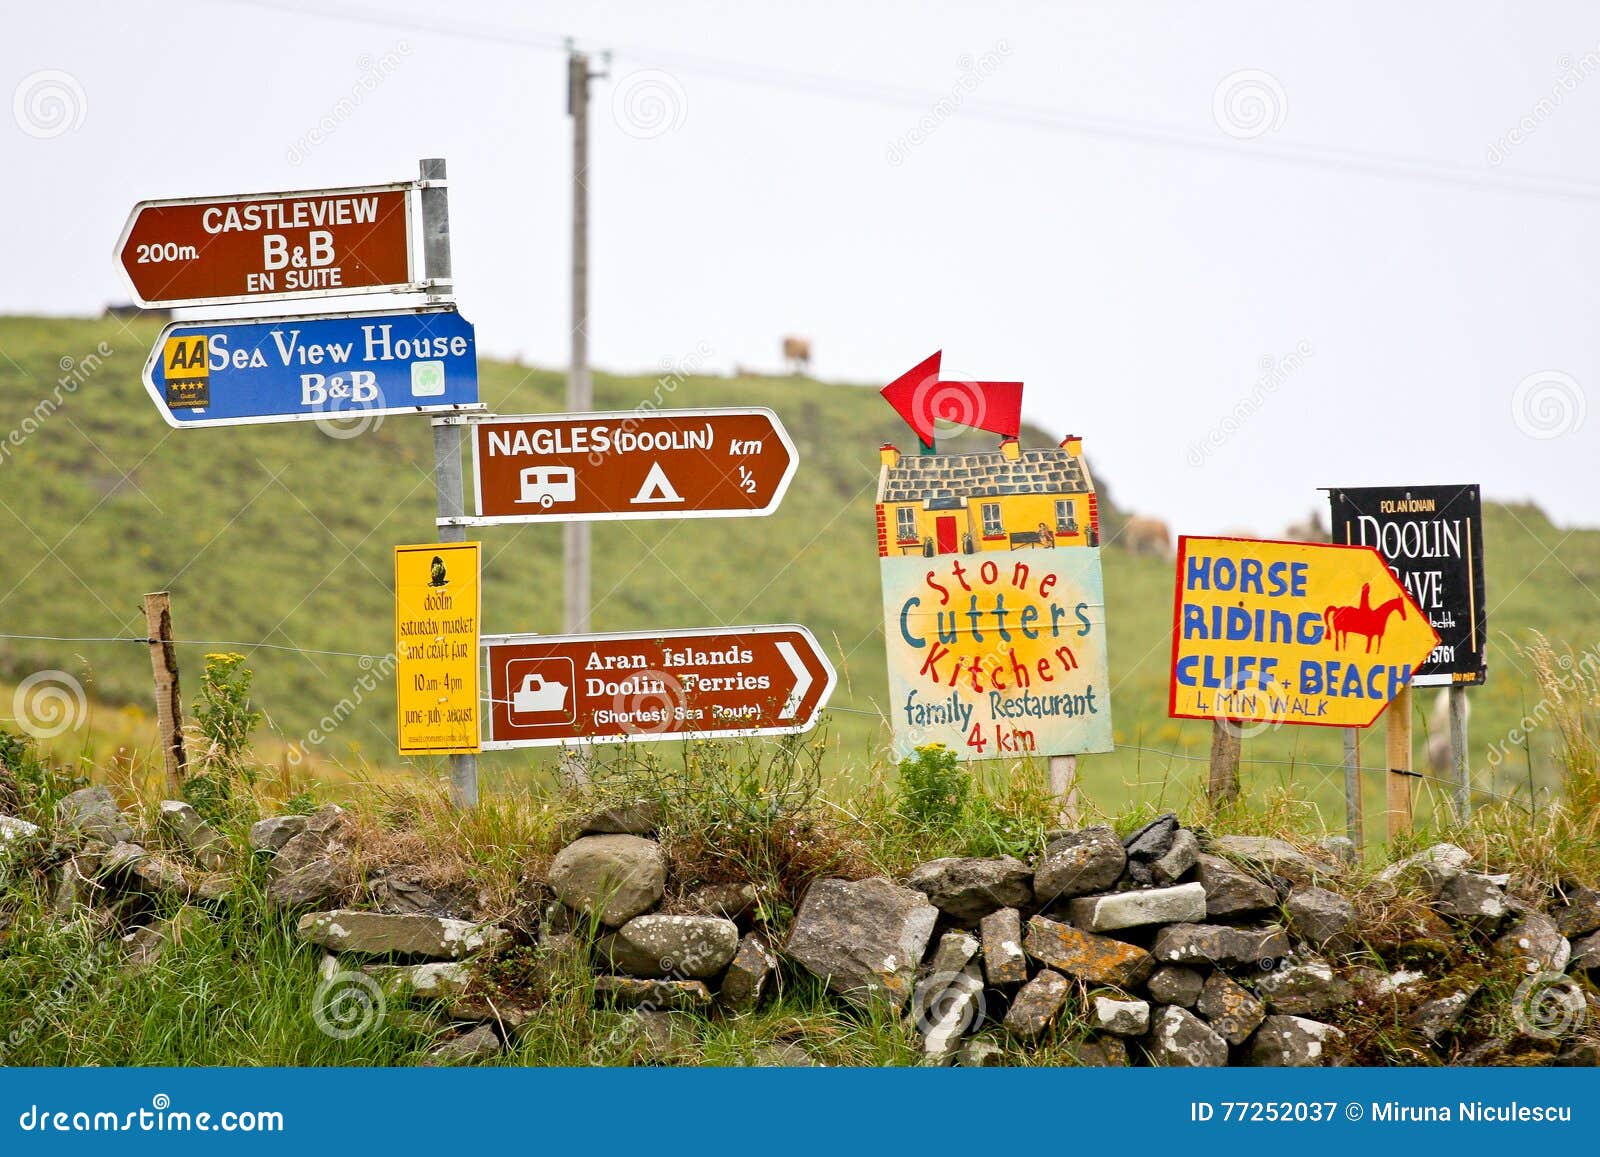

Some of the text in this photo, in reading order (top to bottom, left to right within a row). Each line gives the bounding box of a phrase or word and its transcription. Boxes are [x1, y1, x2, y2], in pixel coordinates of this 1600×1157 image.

[202, 197, 378, 234] CASTLEVIEW
[263, 230, 335, 271] B&B
[247, 267, 342, 292] EN SUITE
[169, 340, 206, 370] AA
[208, 324, 467, 371] Sea View House
[300, 370, 378, 405] B&B
[488, 423, 762, 457] NAGLES (DOOLIN) km
[1358, 515, 1461, 559] DOOLIN
[926, 559, 1057, 606] Stone
[1187, 556, 1308, 597] HORSE
[1388, 566, 1443, 609] AVE
[900, 593, 1091, 649] Cutters
[585, 646, 753, 671] Aran Islands
[920, 641, 1079, 693] Kitchen
[585, 672, 770, 697] Doolin Ferries
[1176, 655, 1278, 692] CLIFF
[1300, 659, 1412, 702] BEACH
[593, 703, 761, 727] (Shortest Sea Route)
[904, 684, 1098, 732] family Restaurant
[1216, 692, 1257, 714] MIN
[1269, 694, 1329, 716] WALK
[967, 722, 1036, 753] 4 km
